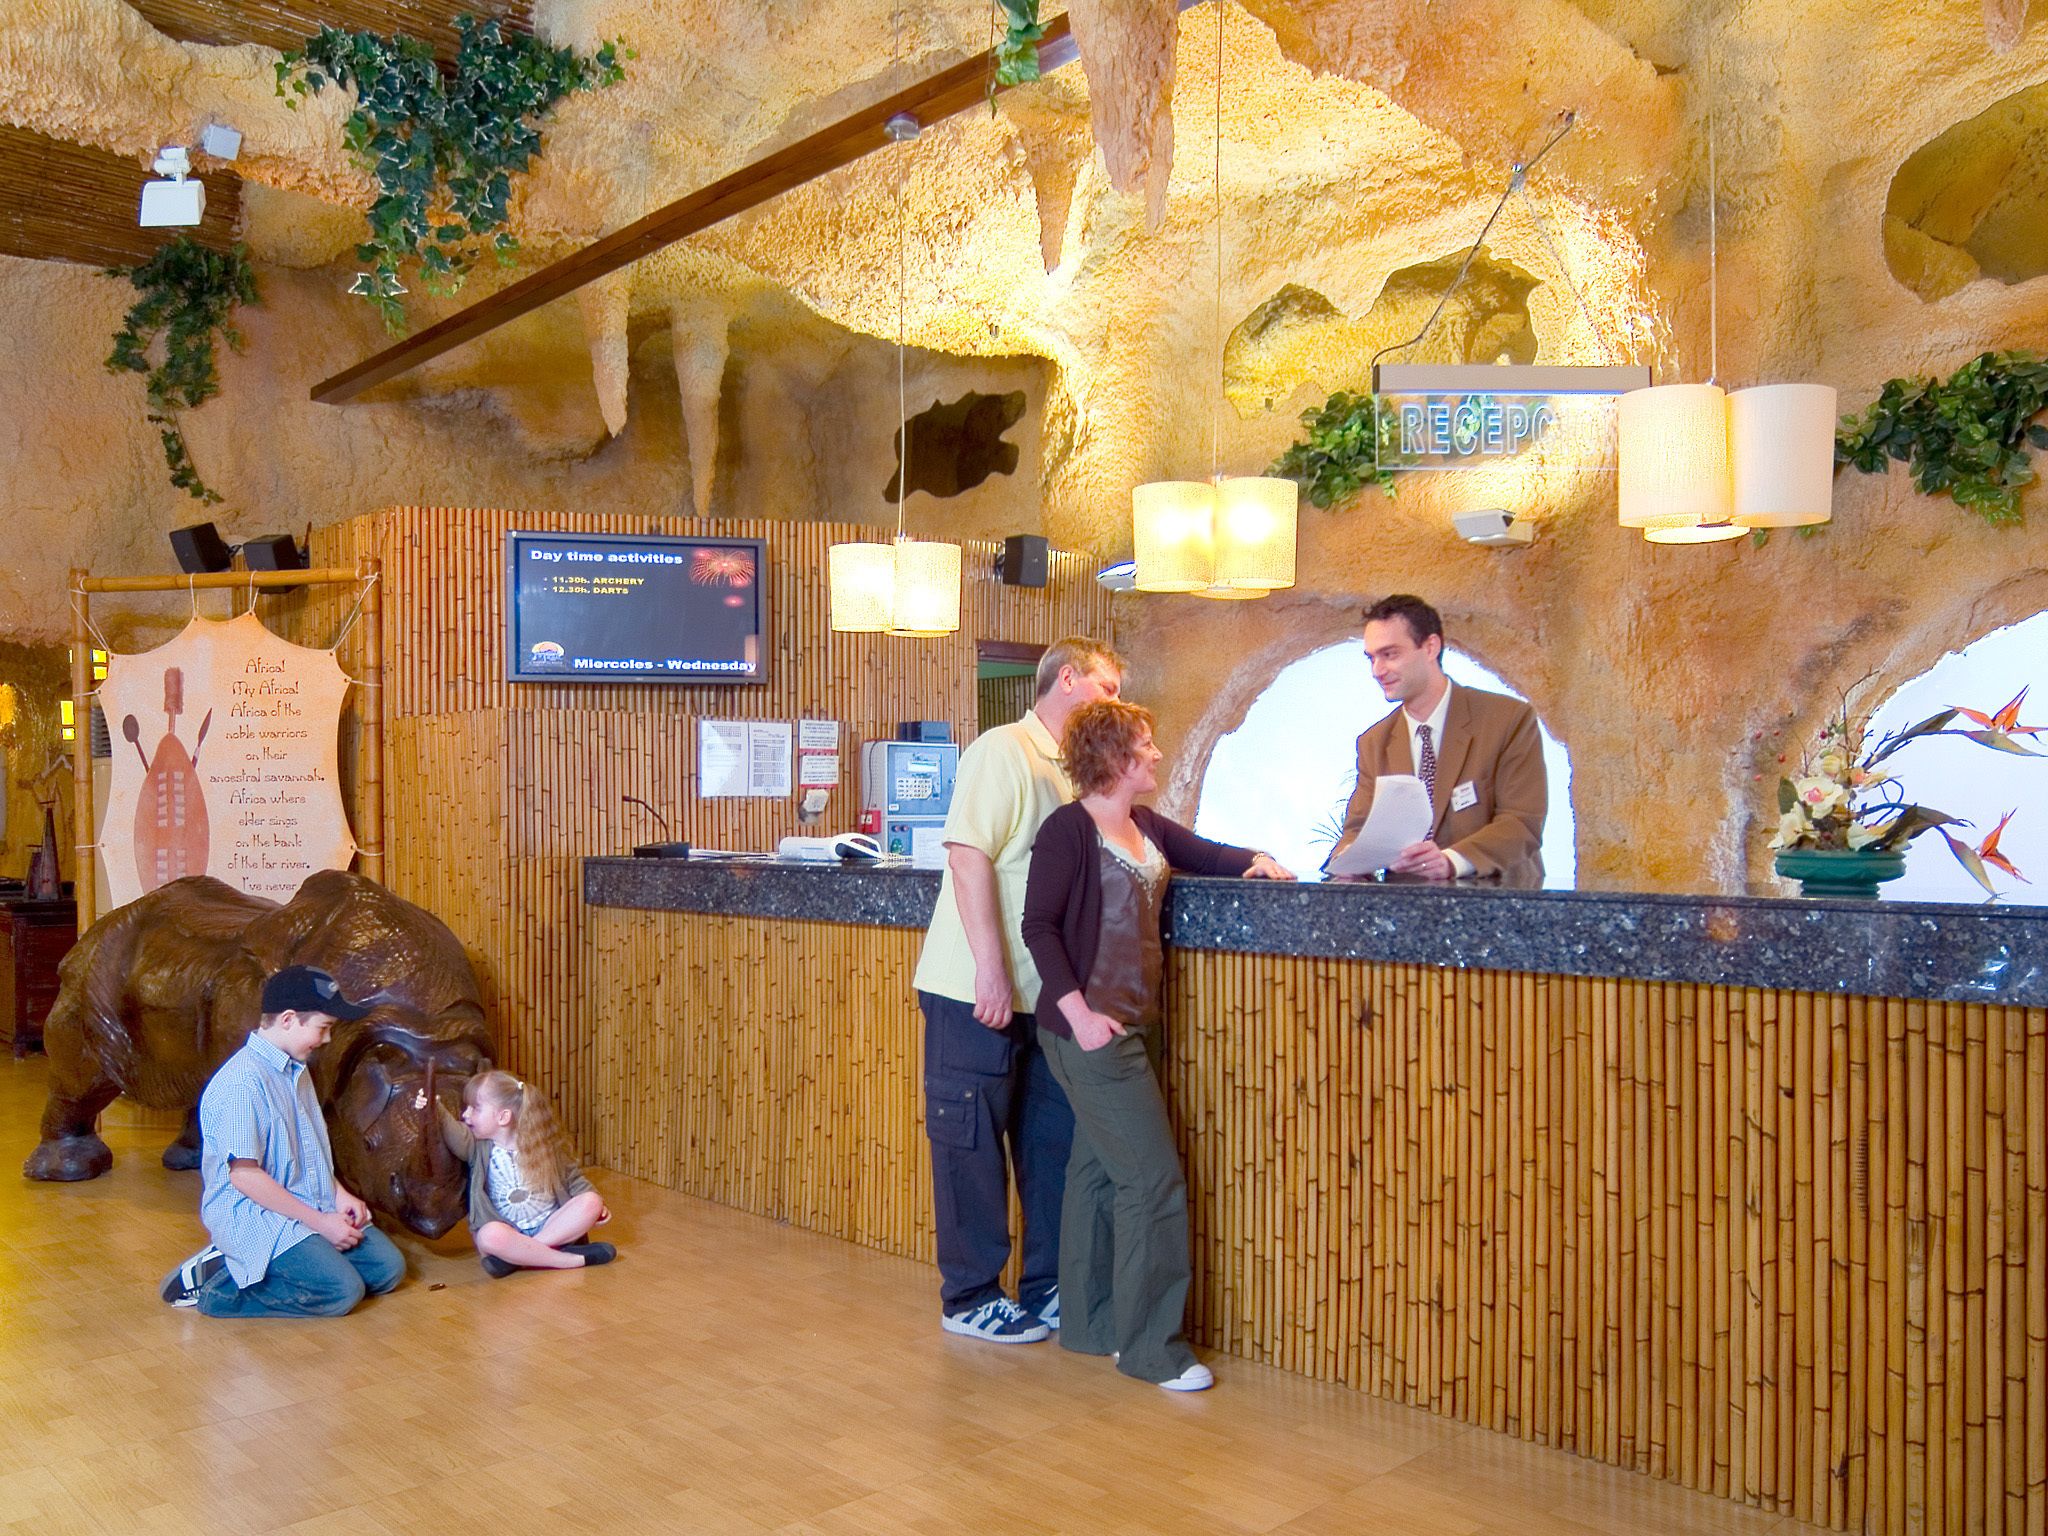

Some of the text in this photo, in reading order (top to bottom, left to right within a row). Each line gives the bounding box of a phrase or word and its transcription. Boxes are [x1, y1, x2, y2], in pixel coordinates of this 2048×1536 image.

[531, 550, 683, 565] Day time activities
[593, 577, 644, 585] ARCHERY
[667, 660, 756, 672] Wednesday
[232, 678, 299, 698] My Africa!
[231, 700, 302, 717] Africa of the
[225, 725, 308, 739] noble warriors
[245, 746, 288, 761] on their
[209, 768, 325, 783] ancestral savannah.
[230, 788, 306, 804] Africa where
[239, 811, 298, 828] elder sings
[235, 833, 302, 848] on the bank
[228, 853, 238, 870] of
[241, 855, 258, 870] the
[262, 853, 276, 870] far
[242, 877, 296, 892] I've never
